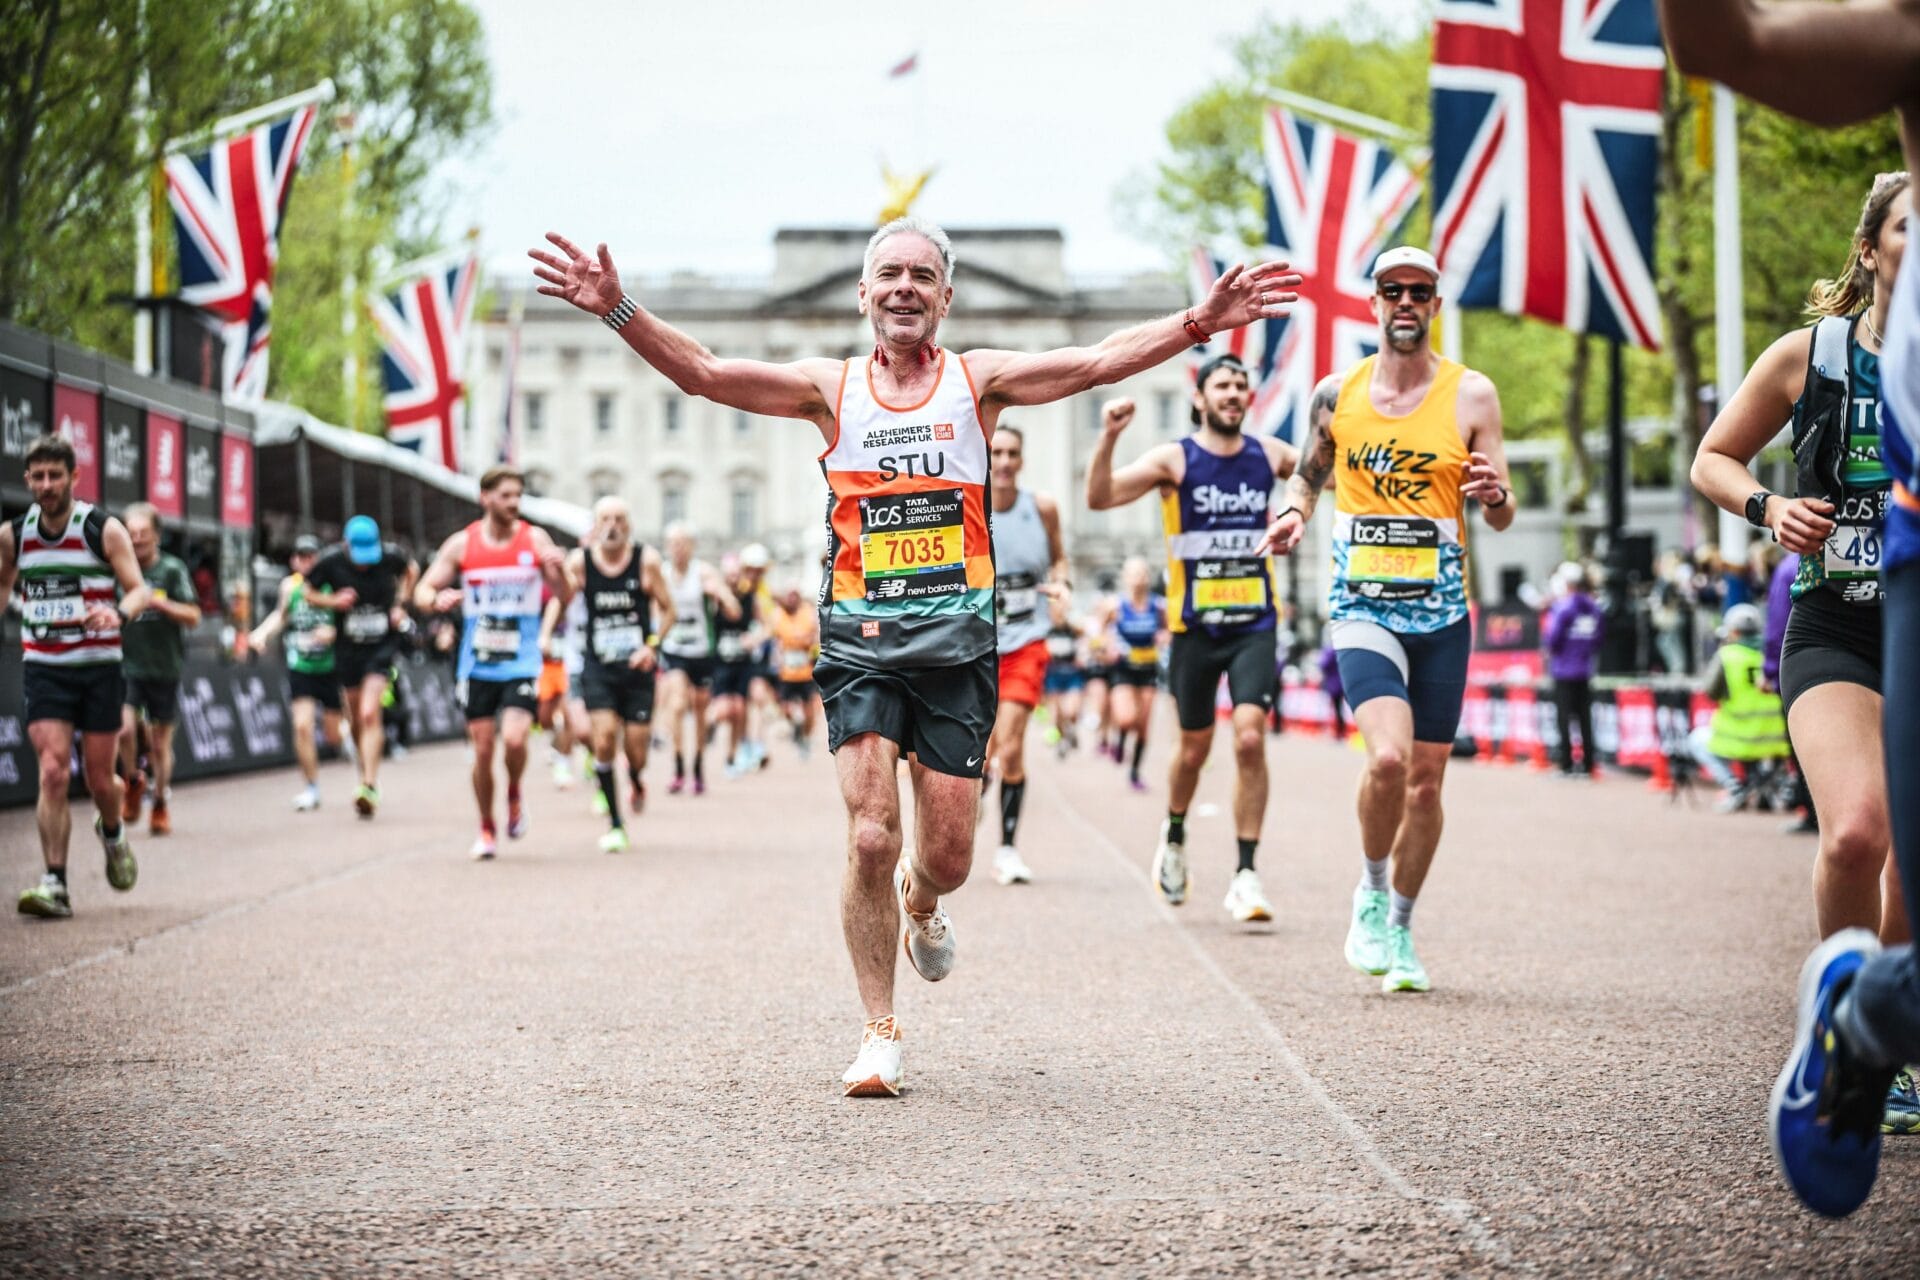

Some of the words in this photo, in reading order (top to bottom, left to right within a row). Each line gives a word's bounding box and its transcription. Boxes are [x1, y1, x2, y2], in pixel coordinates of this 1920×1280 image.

[866, 425, 932, 440] ALZHEIMER'S
[863, 436, 916, 449] RESEARCH
[918, 434, 933, 443] UK
[878, 451, 945, 482] STU
[905, 498, 929, 507] TATA
[1192, 482, 1267, 514] Stroke
[866, 505, 903, 527] tcs
[905, 503, 959, 516] CONSULTANCY
[906, 514, 942, 524] SERVICES
[885, 535, 945, 566] 7035
[1368, 553, 1418, 576] 3587
[907, 587, 926, 596] new
[927, 583, 960, 594] balance
